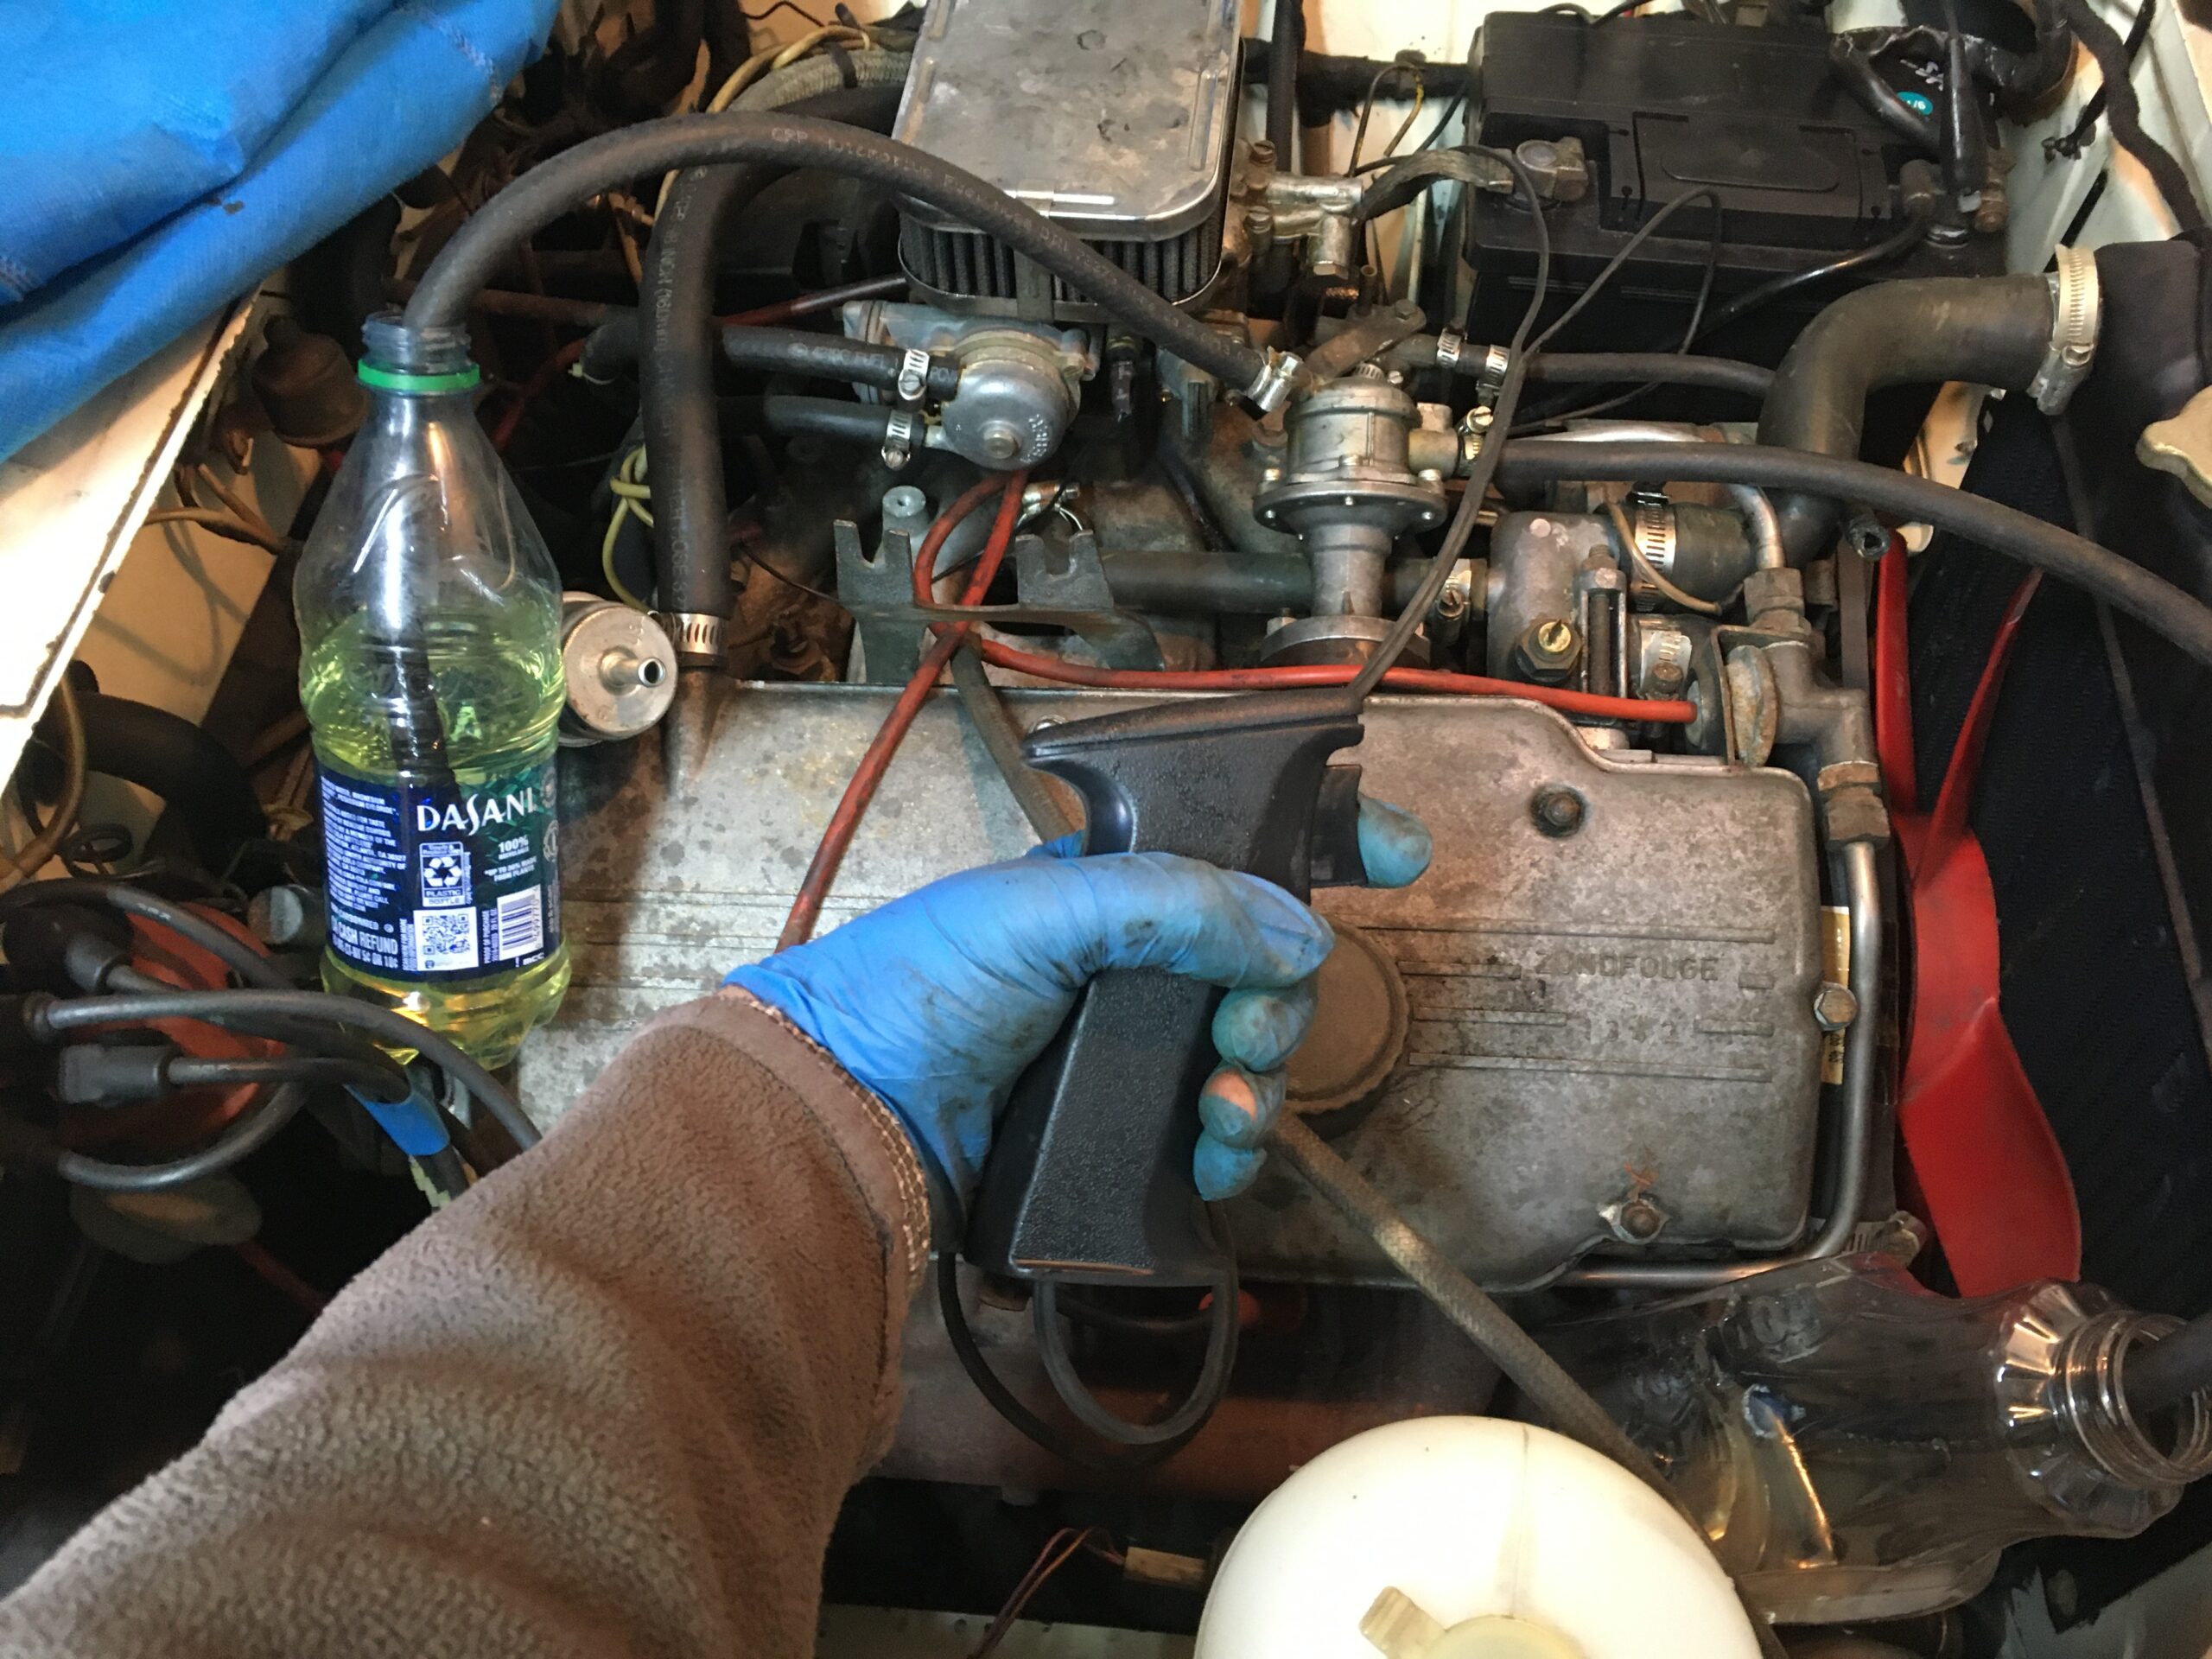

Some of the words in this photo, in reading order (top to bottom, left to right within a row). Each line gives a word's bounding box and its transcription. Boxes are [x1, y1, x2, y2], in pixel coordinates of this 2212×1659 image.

[416, 787, 537, 836] DASANI
[498, 834, 530, 854] 100%
[426, 889, 461, 898] PLASTIC
[359, 931, 398, 955] REFUND
